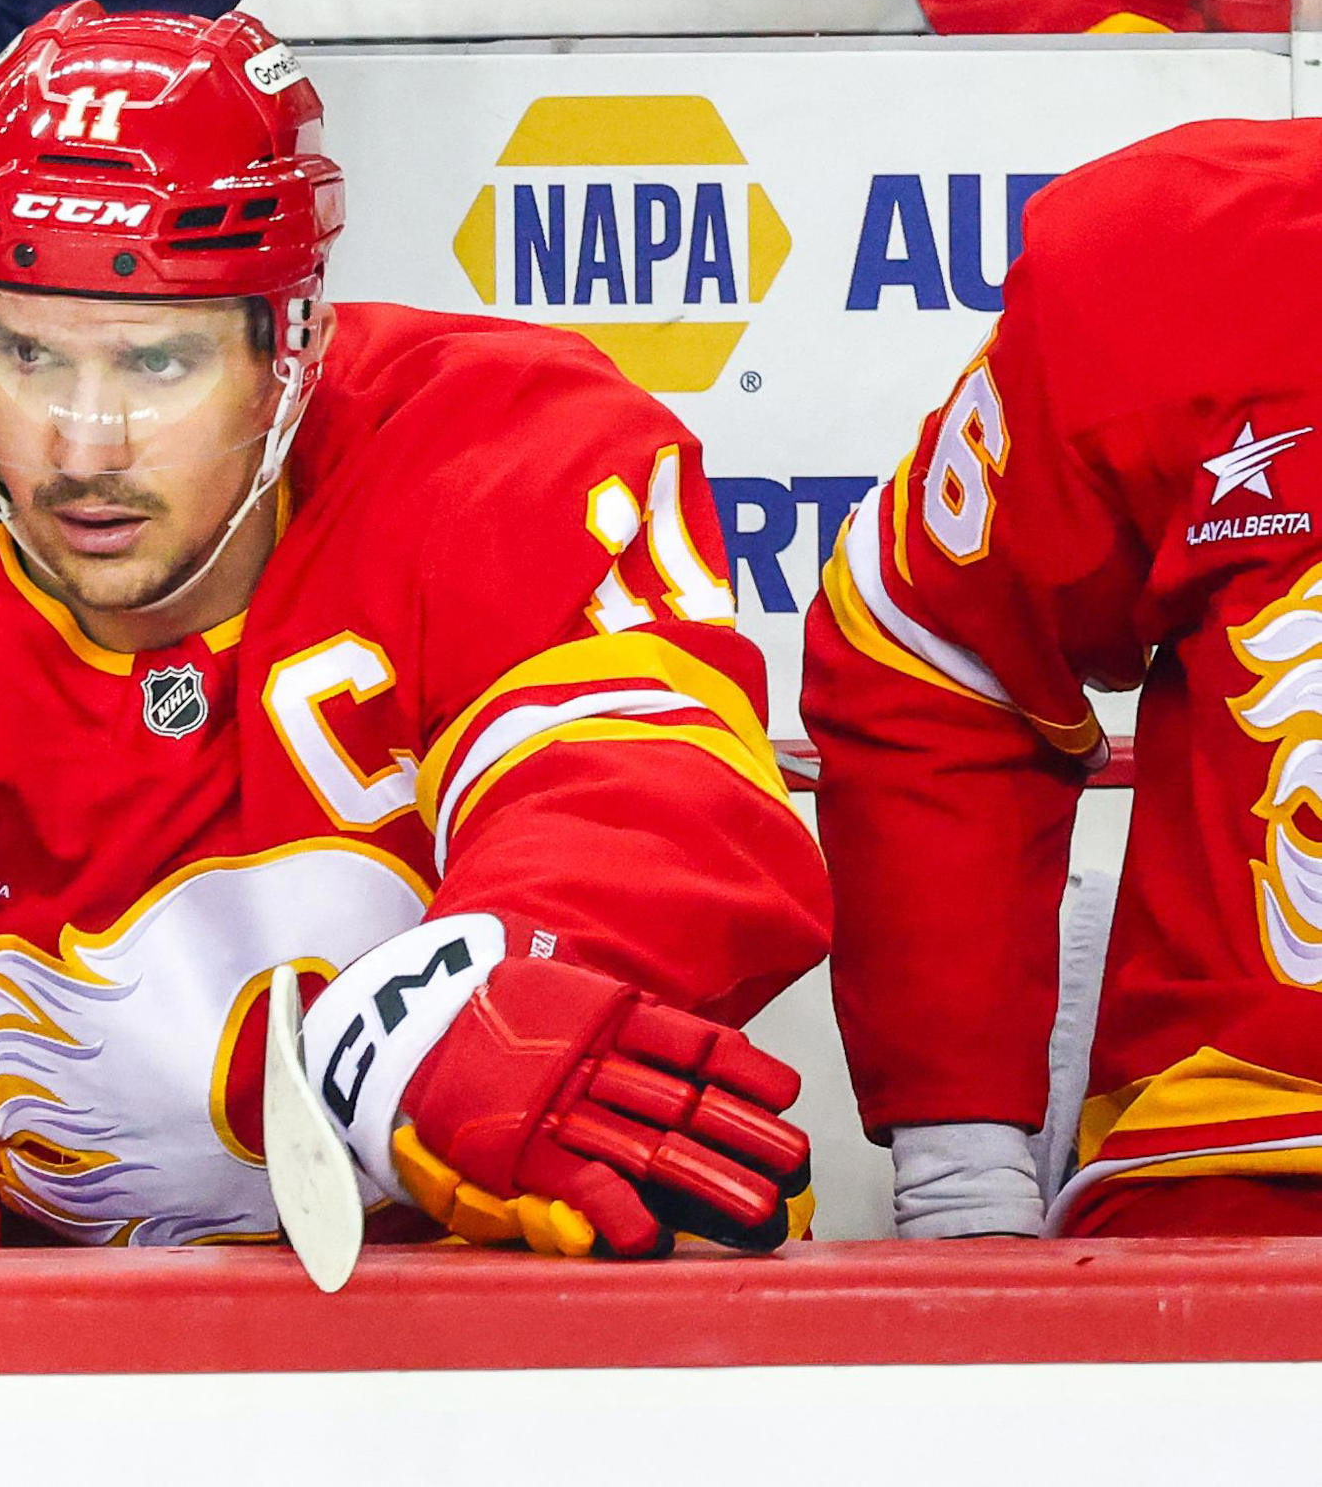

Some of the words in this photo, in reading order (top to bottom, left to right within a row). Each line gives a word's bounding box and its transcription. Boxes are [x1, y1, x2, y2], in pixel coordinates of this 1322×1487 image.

[60, 86, 129, 143] 11
[12, 192, 151, 227] CCM
[513, 183, 738, 305] NAPA
[845, 174, 1063, 312] AU
[923, 355, 1011, 566] 6
[157, 683, 193, 723] NHL
[262, 629, 420, 833] C
[322, 937, 473, 1143] CM
